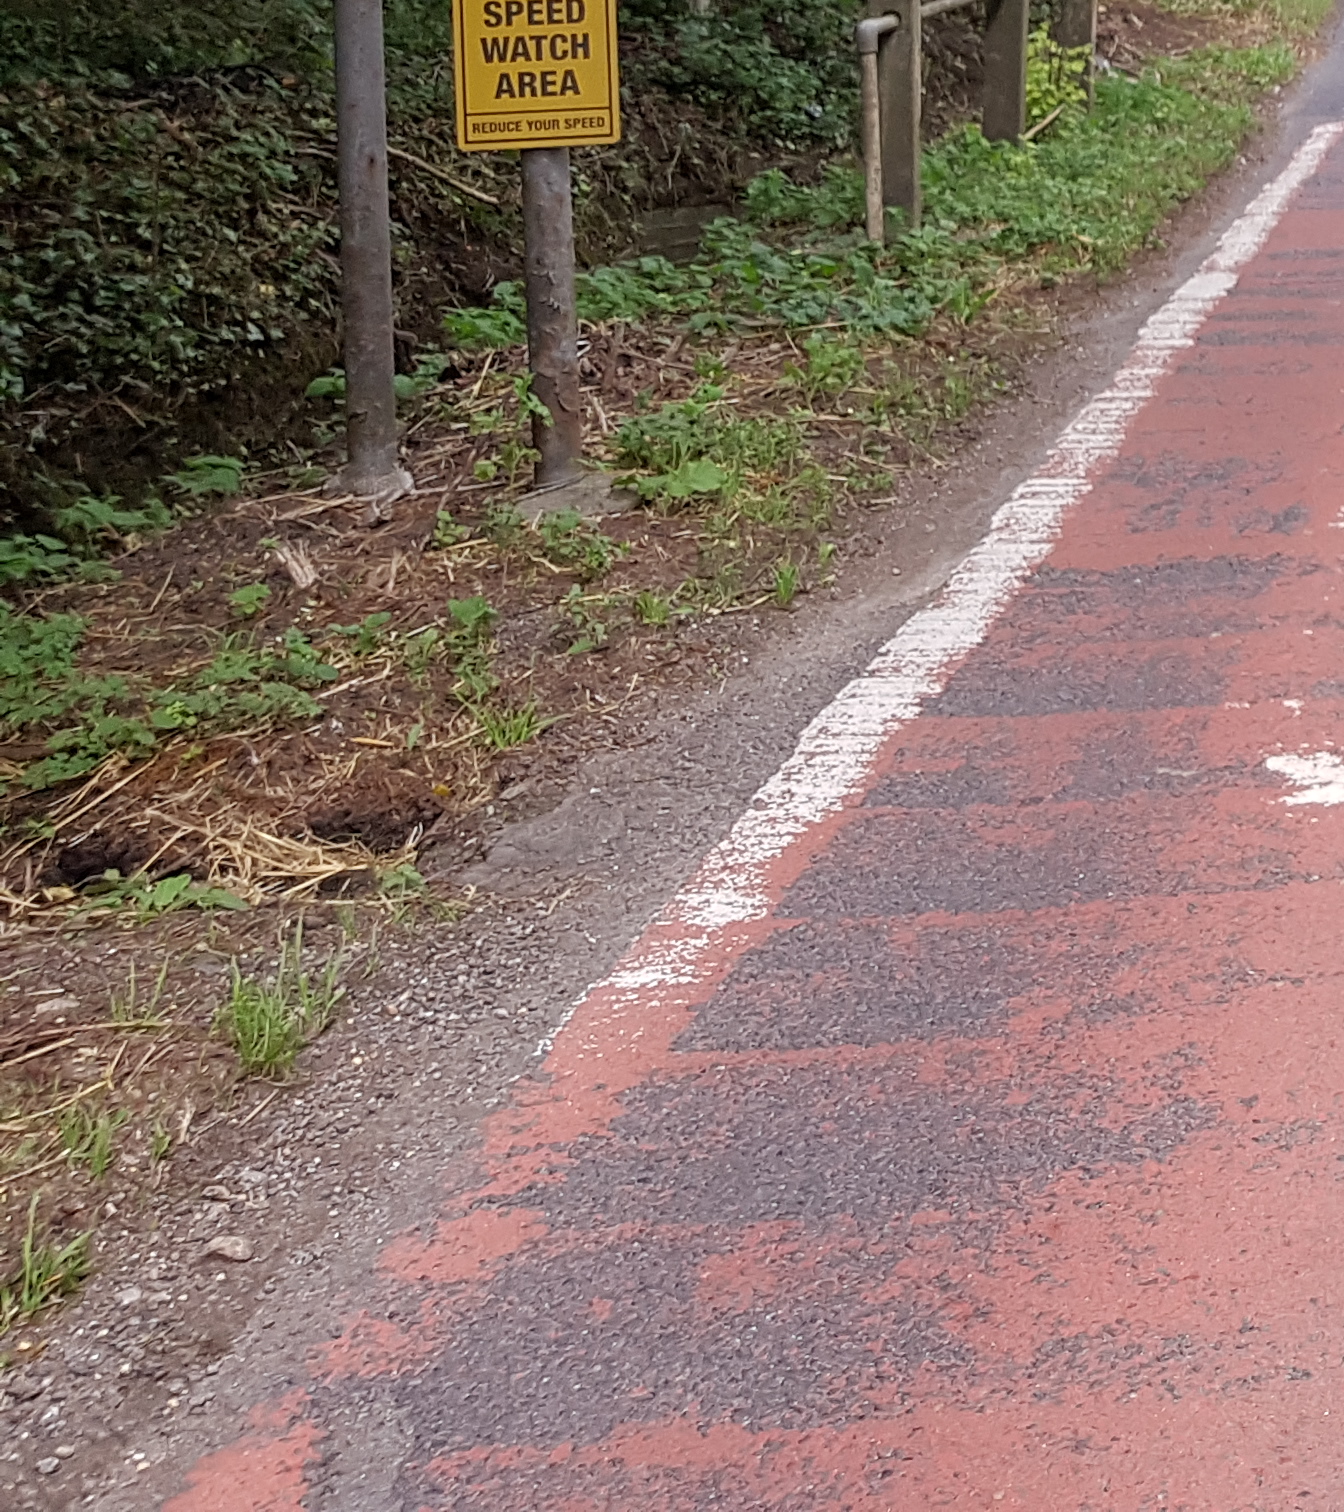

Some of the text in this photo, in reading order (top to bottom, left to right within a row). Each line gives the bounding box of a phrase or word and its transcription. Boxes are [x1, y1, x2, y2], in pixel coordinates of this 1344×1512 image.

[480, 32, 591, 64] WATCH
[494, 69, 581, 100] AREA
[472, 116, 605, 134] REDUCE YOUR SPEED
